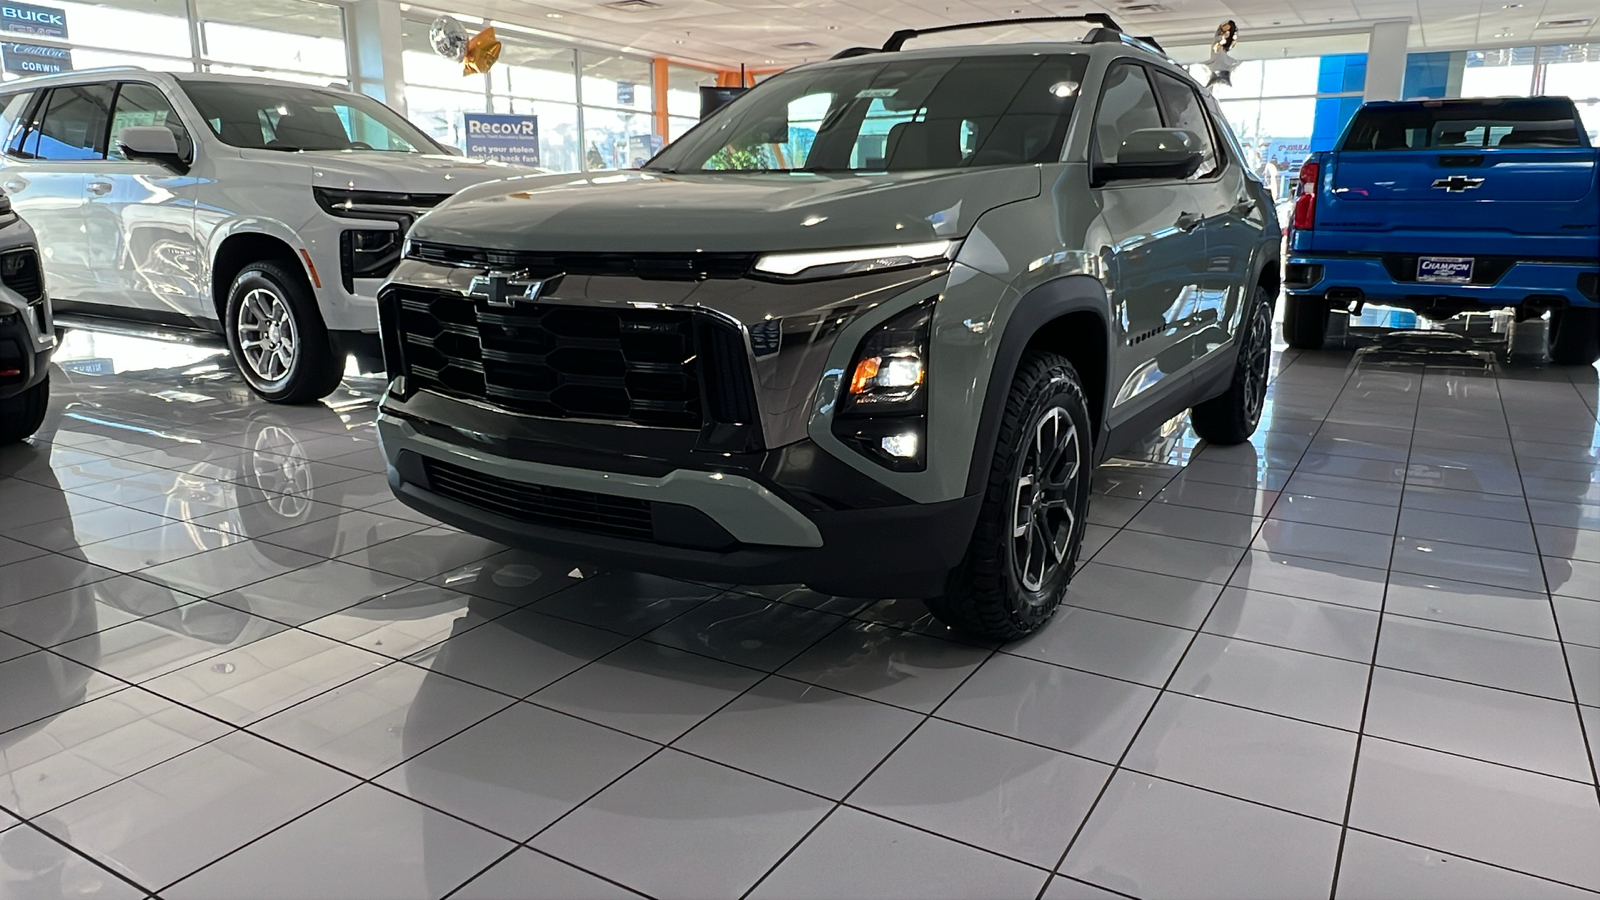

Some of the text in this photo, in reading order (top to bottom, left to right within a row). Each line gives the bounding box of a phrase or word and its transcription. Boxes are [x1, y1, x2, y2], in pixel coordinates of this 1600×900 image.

[2, 7, 63, 25] BUICK
[21, 61, 60, 72] CORWIN
[468, 119, 534, 135] RecovR
[472, 145, 487, 153] Get
[1421, 261, 1470, 271] CHAMPION
